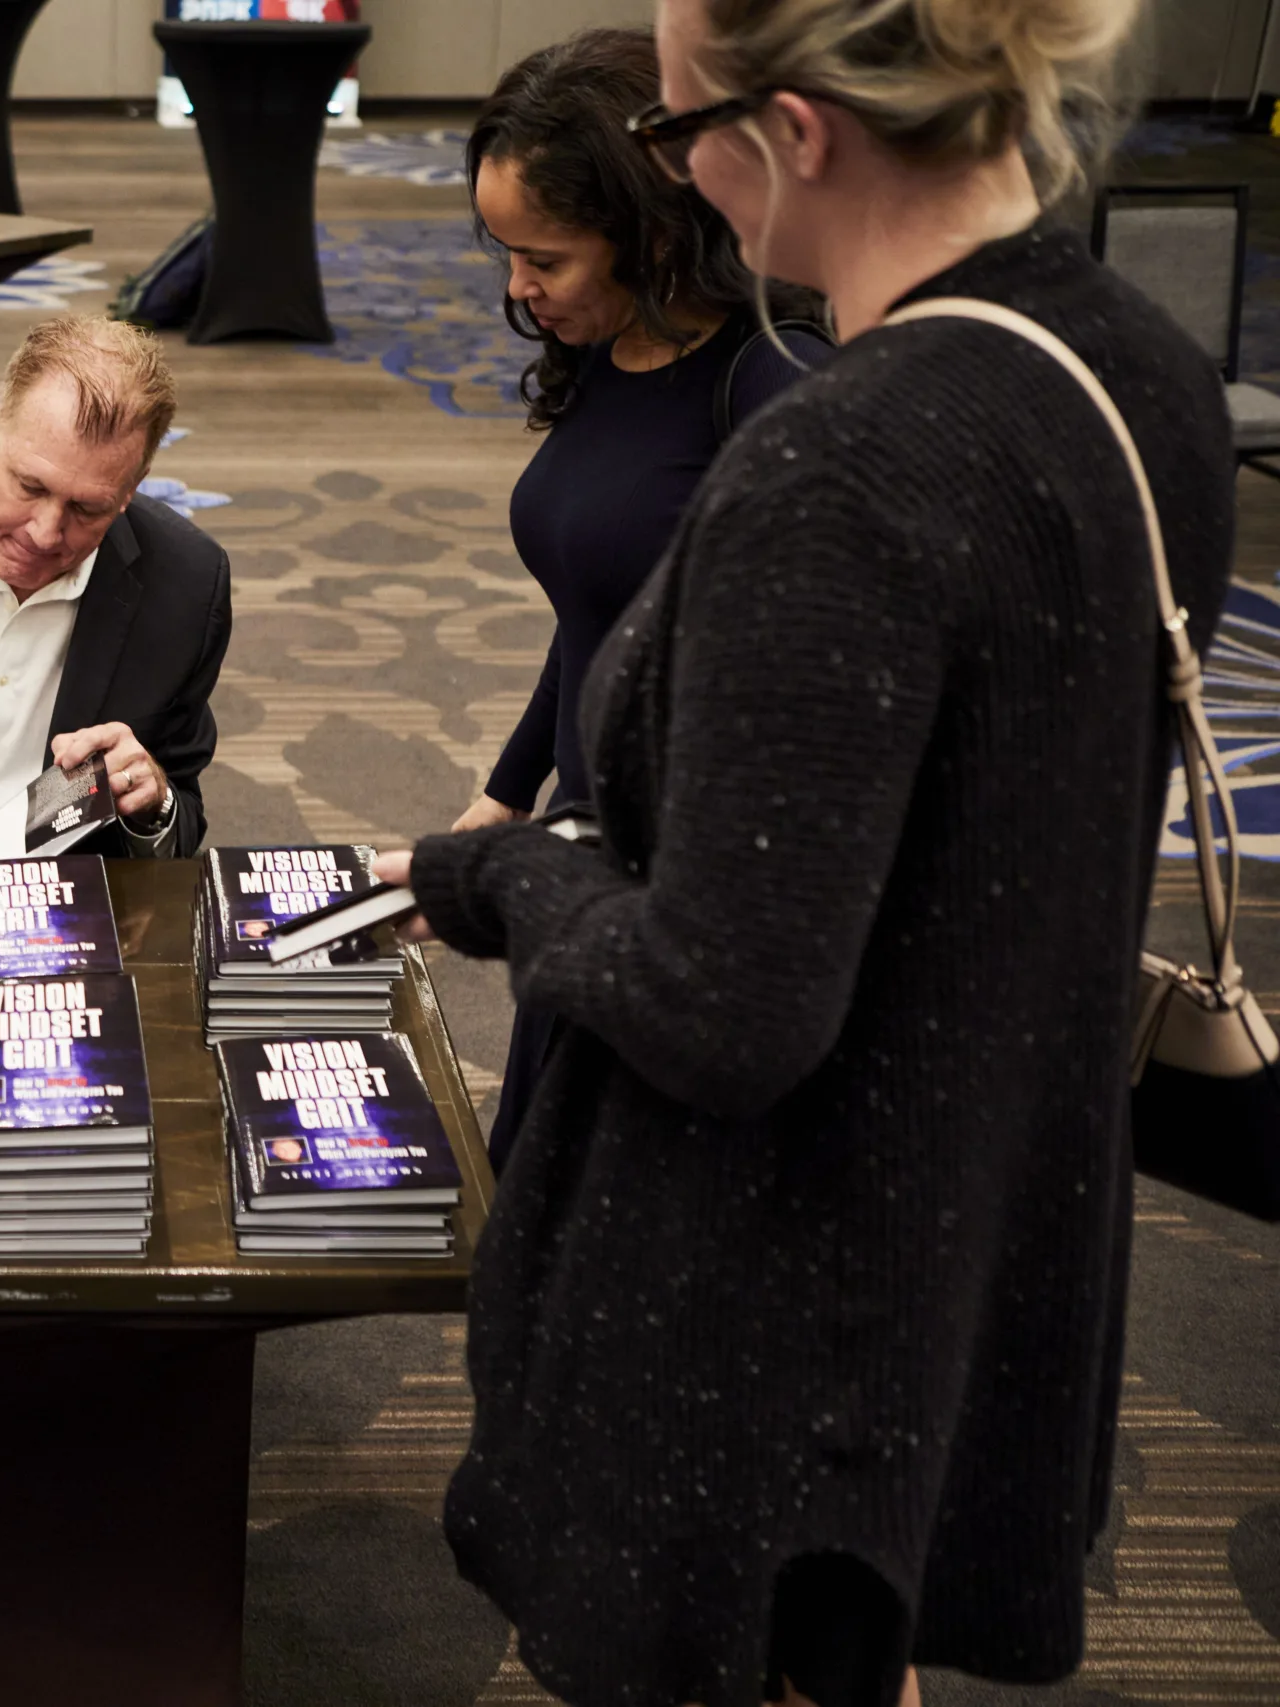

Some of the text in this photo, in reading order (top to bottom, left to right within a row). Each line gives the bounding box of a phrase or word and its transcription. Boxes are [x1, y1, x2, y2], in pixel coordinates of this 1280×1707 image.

[247, 850, 337, 871] VISION
[239, 870, 353, 893] MINDSET
[269, 891, 330, 914] GRIT
[2, 1038, 73, 1069] GRIT
[262, 1040, 368, 1071] VISION
[256, 1067, 390, 1101] MINDSET
[295, 1096, 368, 1129] GRIT
